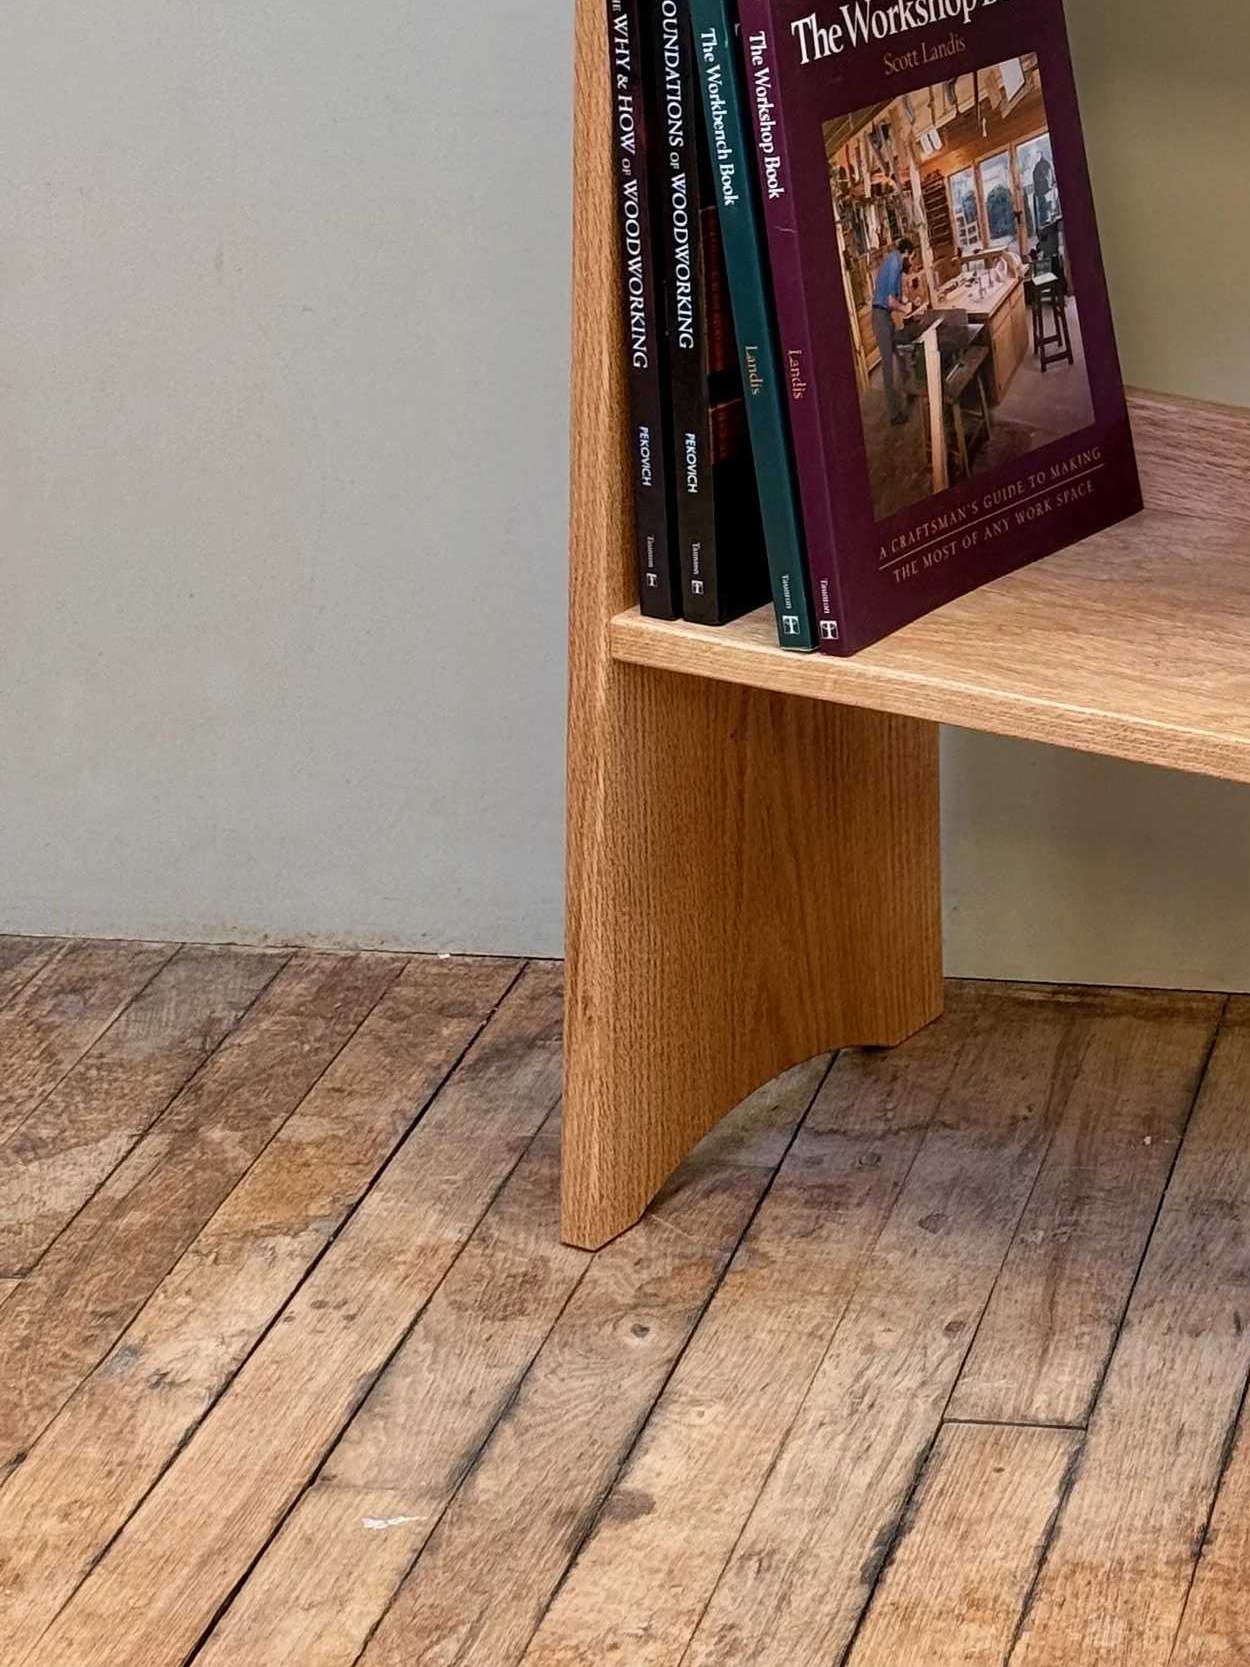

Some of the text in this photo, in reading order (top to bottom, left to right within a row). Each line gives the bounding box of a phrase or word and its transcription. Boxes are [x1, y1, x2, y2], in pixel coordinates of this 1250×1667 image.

[613, 14, 632, 71] WHY
[791, 12, 844, 65] The
[883, 32, 967, 76] Scott Landis
[617, 74, 629, 90] &
[618, 96, 636, 155] HOW
[701, 27, 739, 207] The Workbench Book
[749, 31, 785, 199] The Workshop Book
[622, 158, 632, 176] OF
[670, 151, 680, 170] OF
[623, 179, 648, 369] WOODWORKING
[670, 172, 694, 349] WOODWORKING
[745, 345, 764, 395] Landis
[788, 349, 807, 400] Landis
[639, 426, 652, 487] PEKOVICH
[685, 432, 698, 493] PEKOVICH
[879, 447, 1102, 561] A CRAFTSMAN'S GUIDE TO MAKING
[892, 480, 1096, 583] THE MOST OF ANY WORK SPACE
